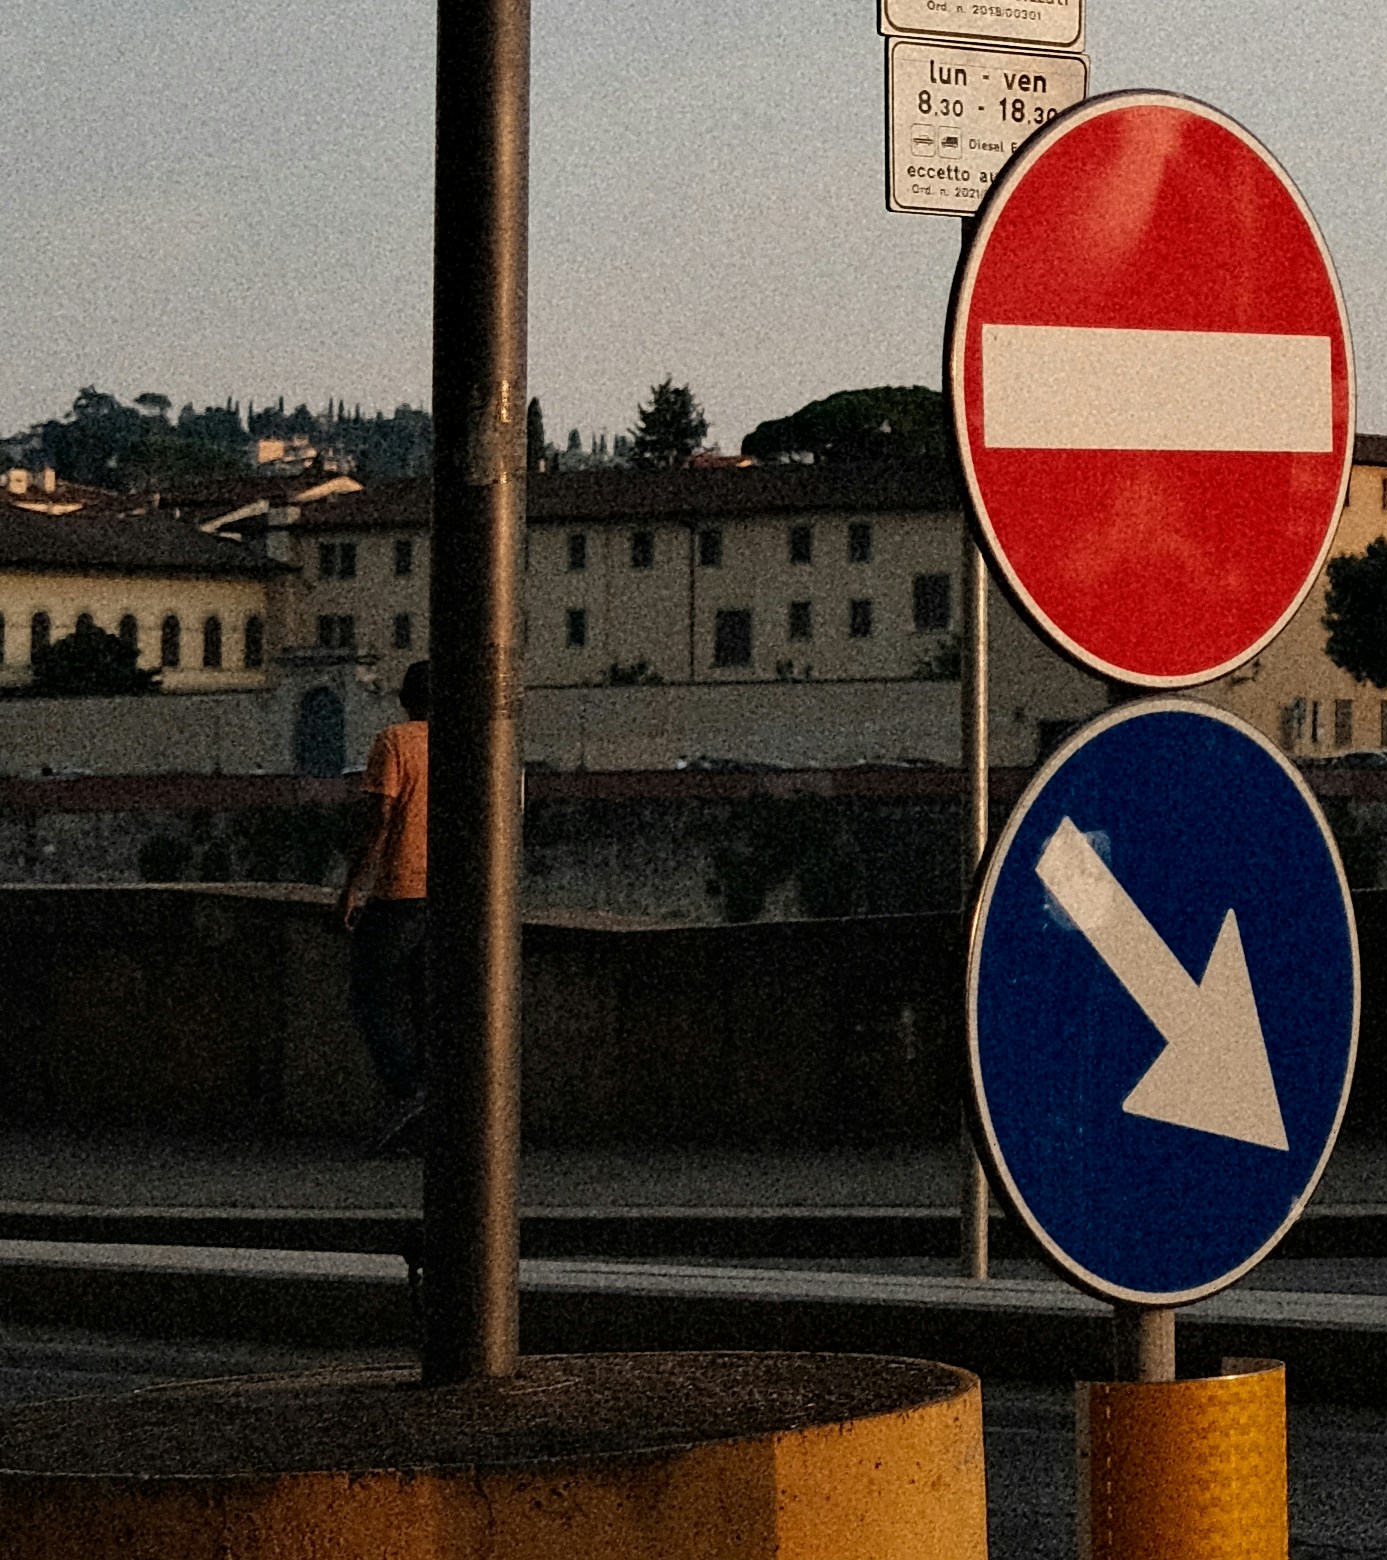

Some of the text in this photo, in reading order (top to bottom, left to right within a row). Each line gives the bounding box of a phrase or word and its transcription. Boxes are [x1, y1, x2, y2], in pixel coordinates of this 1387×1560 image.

[930, 59, 967, 86] lun
[1004, 73, 1047, 93] ven
[918, 90, 964, 117] 8.30
[969, 138, 1004, 153] Diesel
[907, 165, 998, 183] eccetto au
